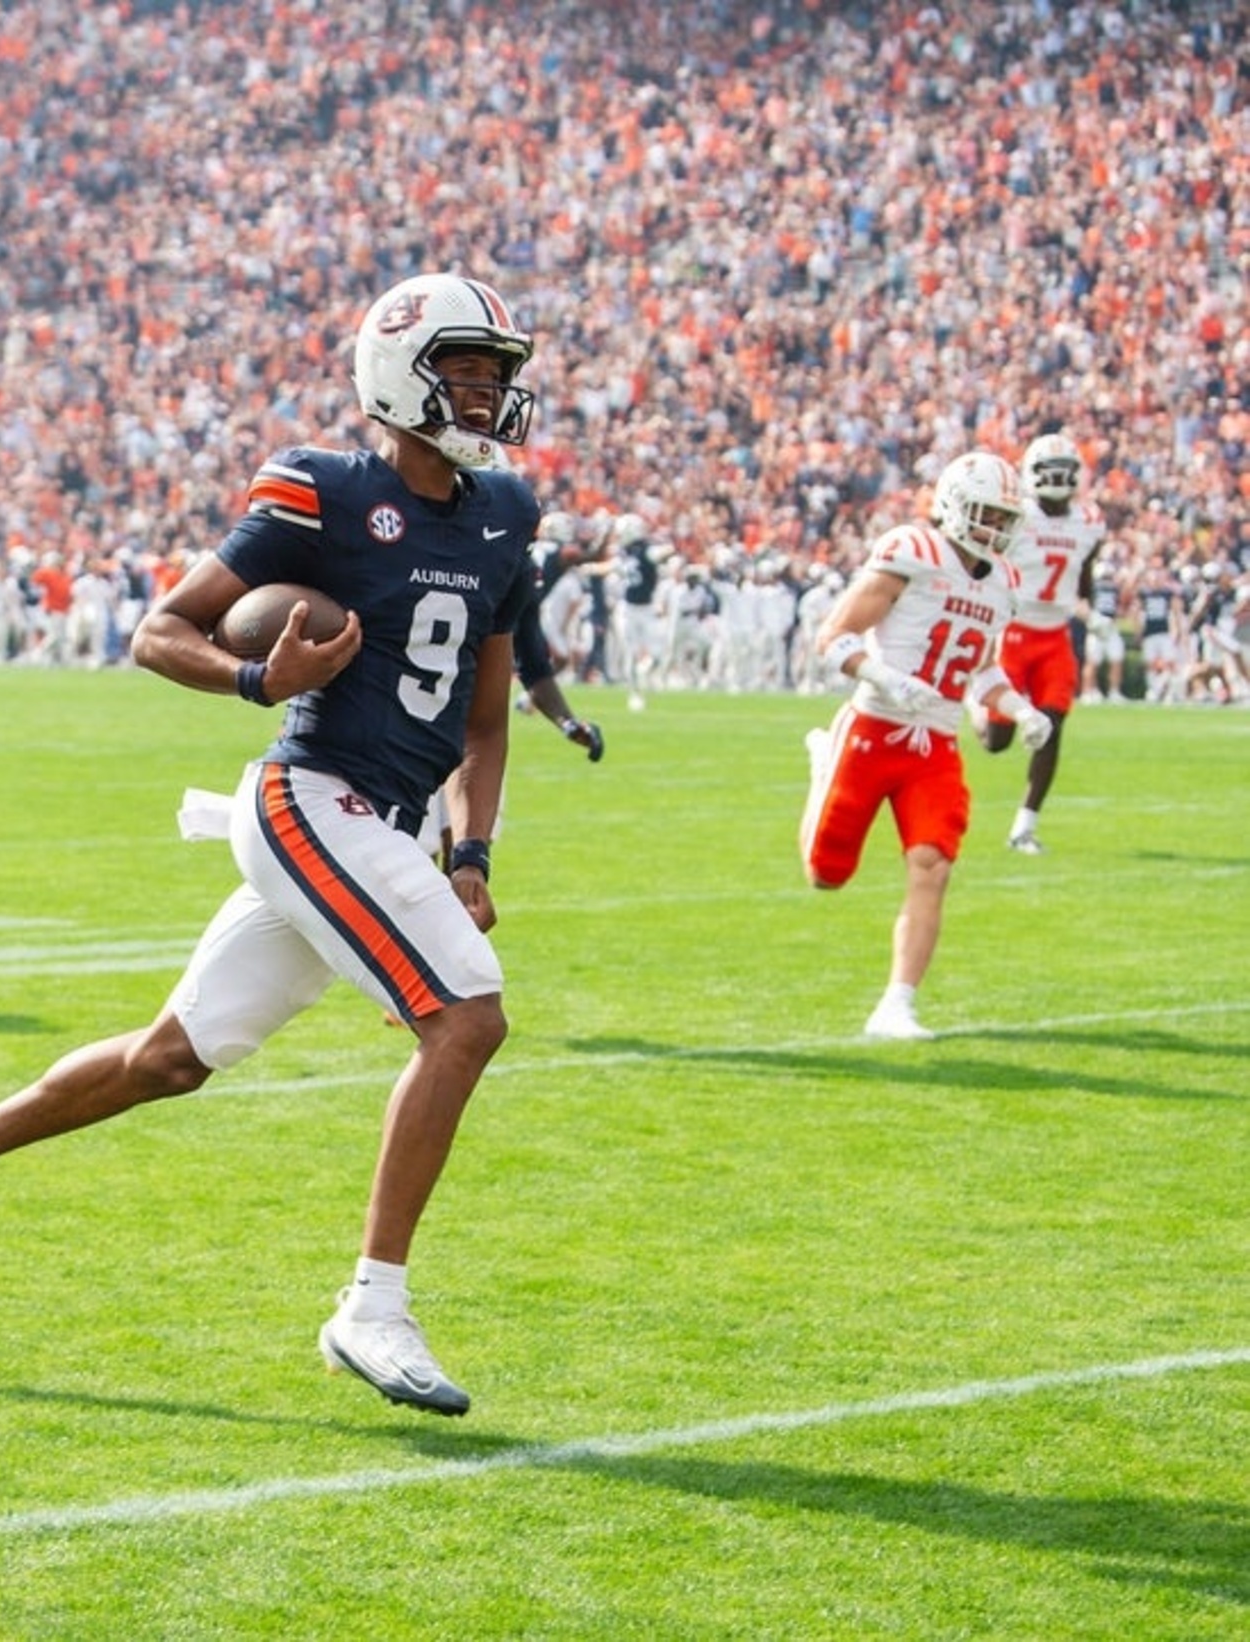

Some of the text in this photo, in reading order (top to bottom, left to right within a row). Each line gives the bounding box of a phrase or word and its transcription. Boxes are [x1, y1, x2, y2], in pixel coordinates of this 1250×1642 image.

[371, 507, 402, 540] SEC
[409, 567, 480, 590] AUBURN
[1038, 554, 1068, 602] 7
[396, 590, 469, 722] 9
[912, 618, 986, 701] 12
